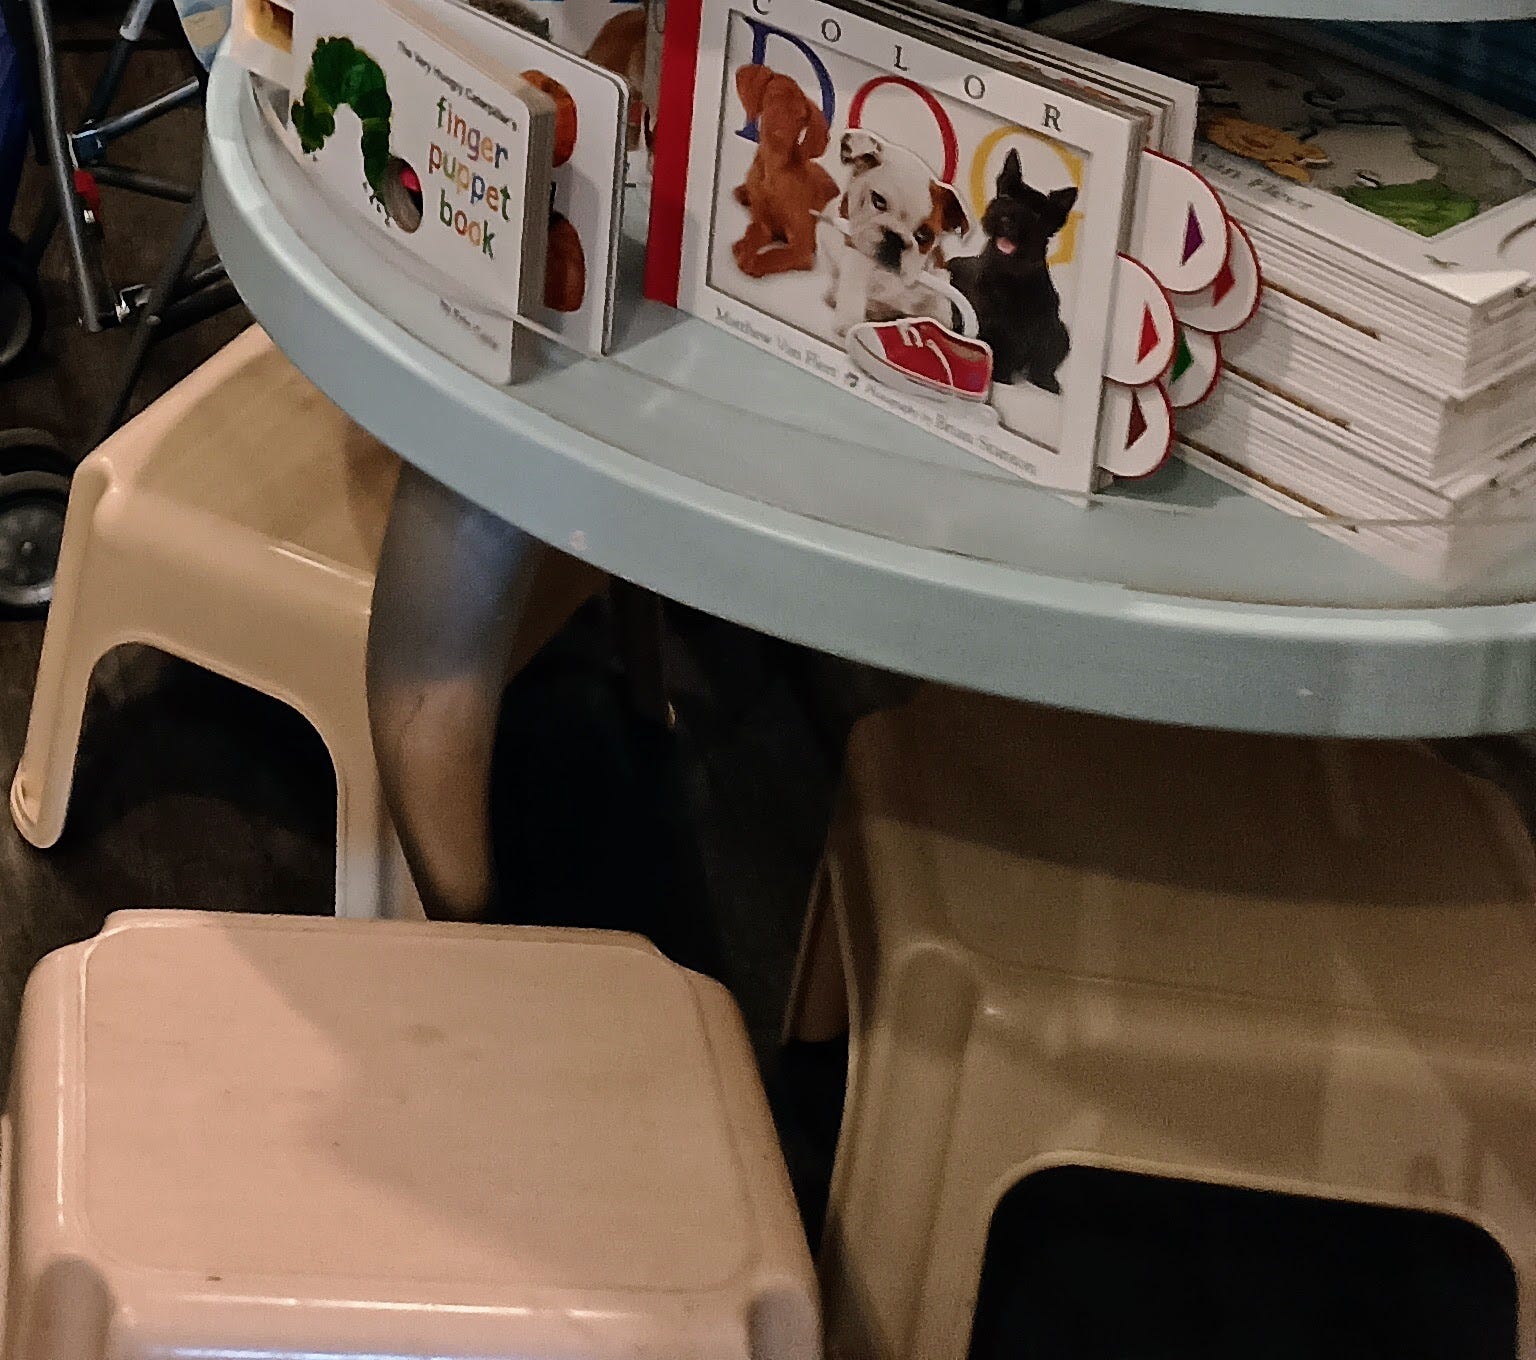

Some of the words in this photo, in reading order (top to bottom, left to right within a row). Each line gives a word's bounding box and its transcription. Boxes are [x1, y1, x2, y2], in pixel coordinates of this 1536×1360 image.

[436, 95, 510, 169] finger
[428, 142, 512, 223] puppet
[439, 187, 496, 261] book
